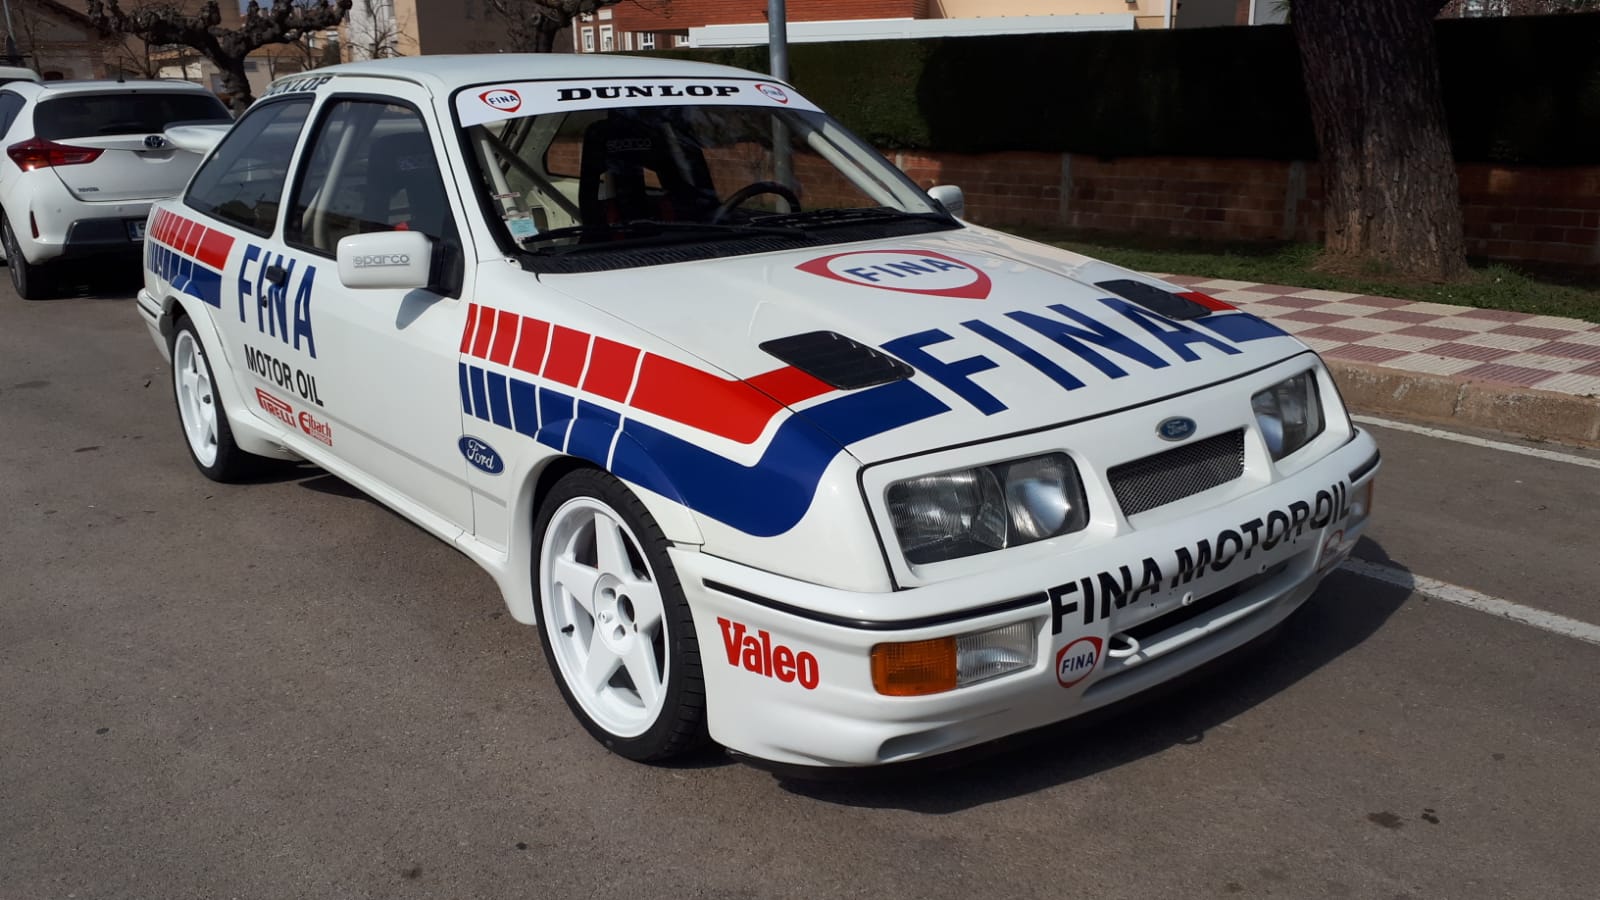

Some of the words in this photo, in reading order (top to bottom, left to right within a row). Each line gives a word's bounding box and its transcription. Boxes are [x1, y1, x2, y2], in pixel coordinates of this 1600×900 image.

[488, 95, 519, 105] FINA
[557, 85, 740, 102] DUNLOP
[353, 254, 410, 268] sparco
[842, 258, 967, 283] FINA
[238, 243, 318, 359] FINA
[879, 297, 1244, 417] FINA
[244, 343, 295, 393] MOTOR
[296, 369, 325, 408] OIL
[255, 387, 298, 428] PIRELLI
[298, 411, 333, 440] Eibach
[467, 439, 495, 470] Ford
[1048, 557, 1164, 636] FINA
[1170, 500, 1310, 589] MOTOR
[1309, 480, 1351, 530] OIL
[717, 617, 820, 690] Valeo
[1061, 652, 1095, 675] FINA
